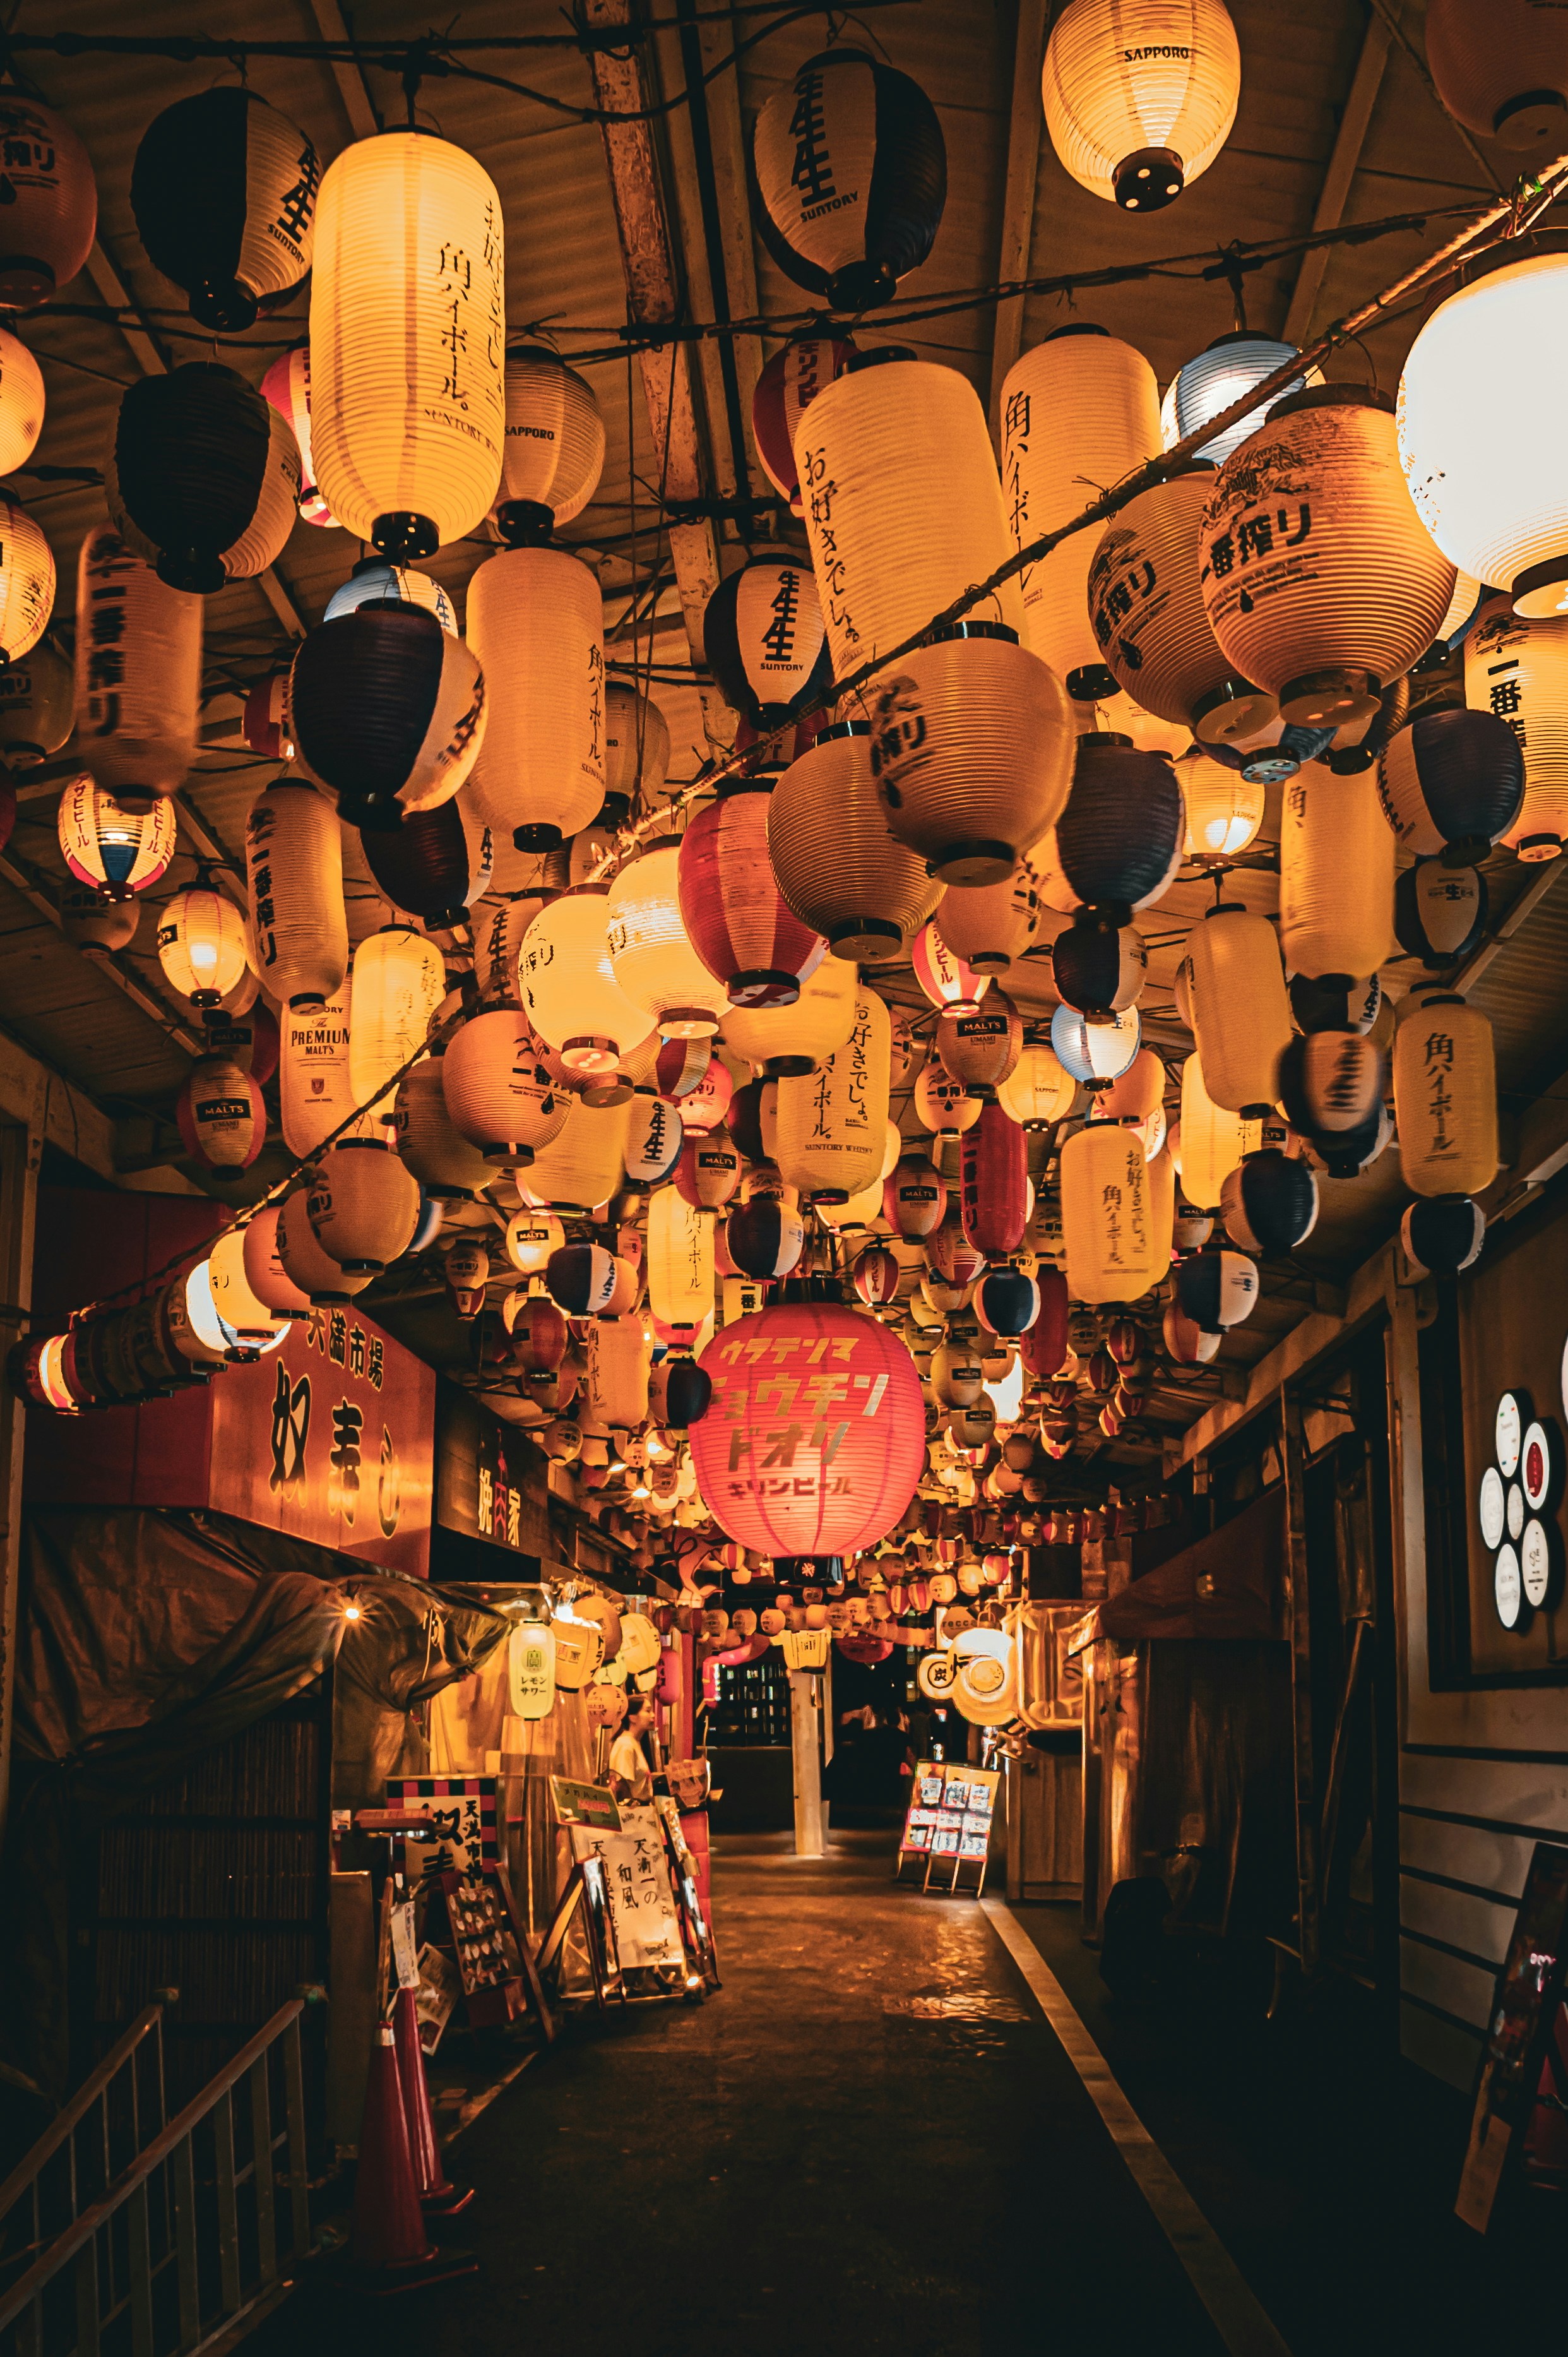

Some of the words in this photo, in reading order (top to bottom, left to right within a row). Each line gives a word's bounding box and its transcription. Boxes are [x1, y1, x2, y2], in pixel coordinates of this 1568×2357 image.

[1124, 46, 1189, 62] SAPPORO
[800, 191, 858, 222] SUNTORY
[267, 224, 305, 265] SUNTORY
[505, 426, 555, 441] SAPPORO
[761, 570, 800, 662] 生生生
[760, 663, 804, 671] SUNTORY
[964, 1020, 1001, 1031] MALT'S
[305, 1045, 335, 1056] MALT'S
[1424, 1032, 1454, 1150] 角ハイボール
[205, 1105, 244, 1116] MALT'S
[643, 1101, 665, 1161] 生生生
[705, 1157, 733, 1166] MALT'S
[719, 1337, 860, 1366] ウラテンマ
[728, 1421, 852, 1472] ドオリ
[728, 1477, 853, 1500] キリンビール
[521, 1676, 547, 1685] レモン
[520, 1687, 547, 1697] サワー
[616, 1863, 639, 1910] 和風
